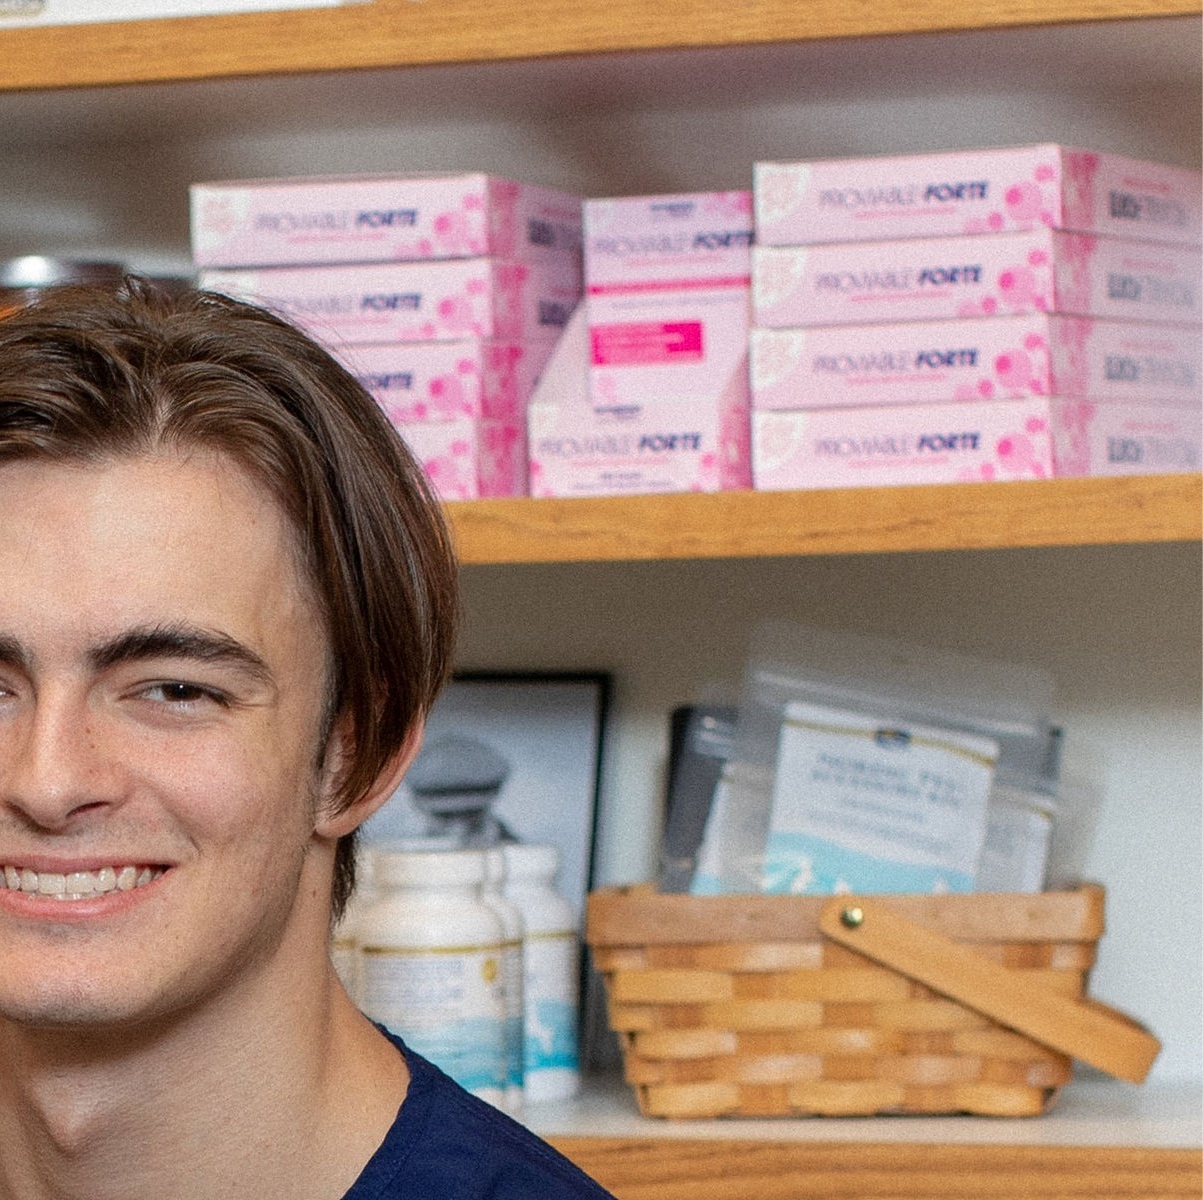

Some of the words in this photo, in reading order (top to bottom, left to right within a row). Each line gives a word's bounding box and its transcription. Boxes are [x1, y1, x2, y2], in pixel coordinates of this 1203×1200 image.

[924, 180, 990, 201] FORTE
[918, 264, 983, 285] FORTE
[915, 348, 980, 369] FORTE
[639, 432, 702, 451] FORTE
[917, 432, 981, 453] FORTE
